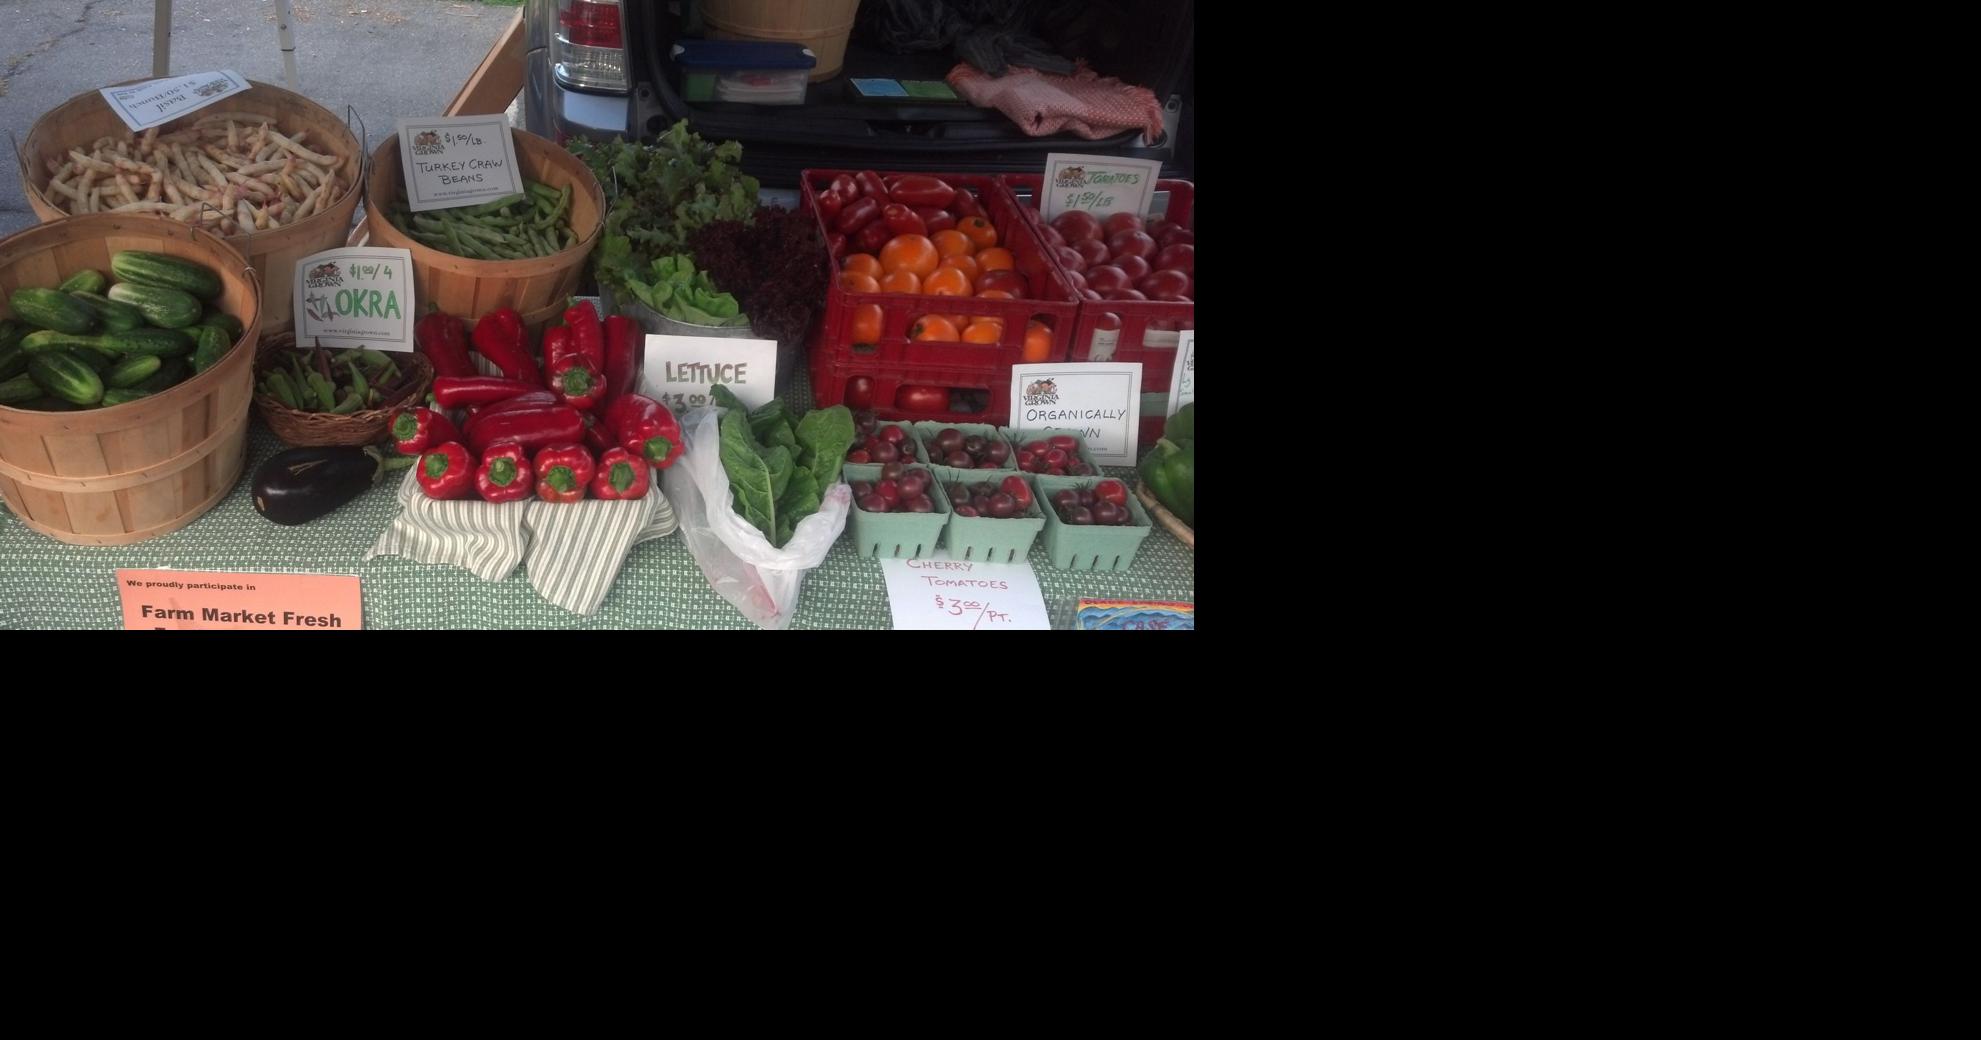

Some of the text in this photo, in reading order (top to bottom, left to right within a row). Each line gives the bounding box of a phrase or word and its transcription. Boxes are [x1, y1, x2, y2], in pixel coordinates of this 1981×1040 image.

[416, 159, 503, 173] TURKEY CRAW
[438, 174, 483, 185] BEANS
[1088, 171, 1139, 185] TOMATOES
[383, 265, 392, 279] 4
[306, 276, 344, 285] VIRGINIA
[334, 289, 402, 320] OKRA
[665, 361, 747, 384] LETTUCE
[1026, 409, 1126, 421] ORGANICALLY
[906, 558, 973, 572] CHERRY
[146, 580, 184, 590] proudly
[187, 582, 244, 591] participate
[921, 576, 1008, 590] TOMATOES
[142, 605, 342, 627] Farm Market Fresh
